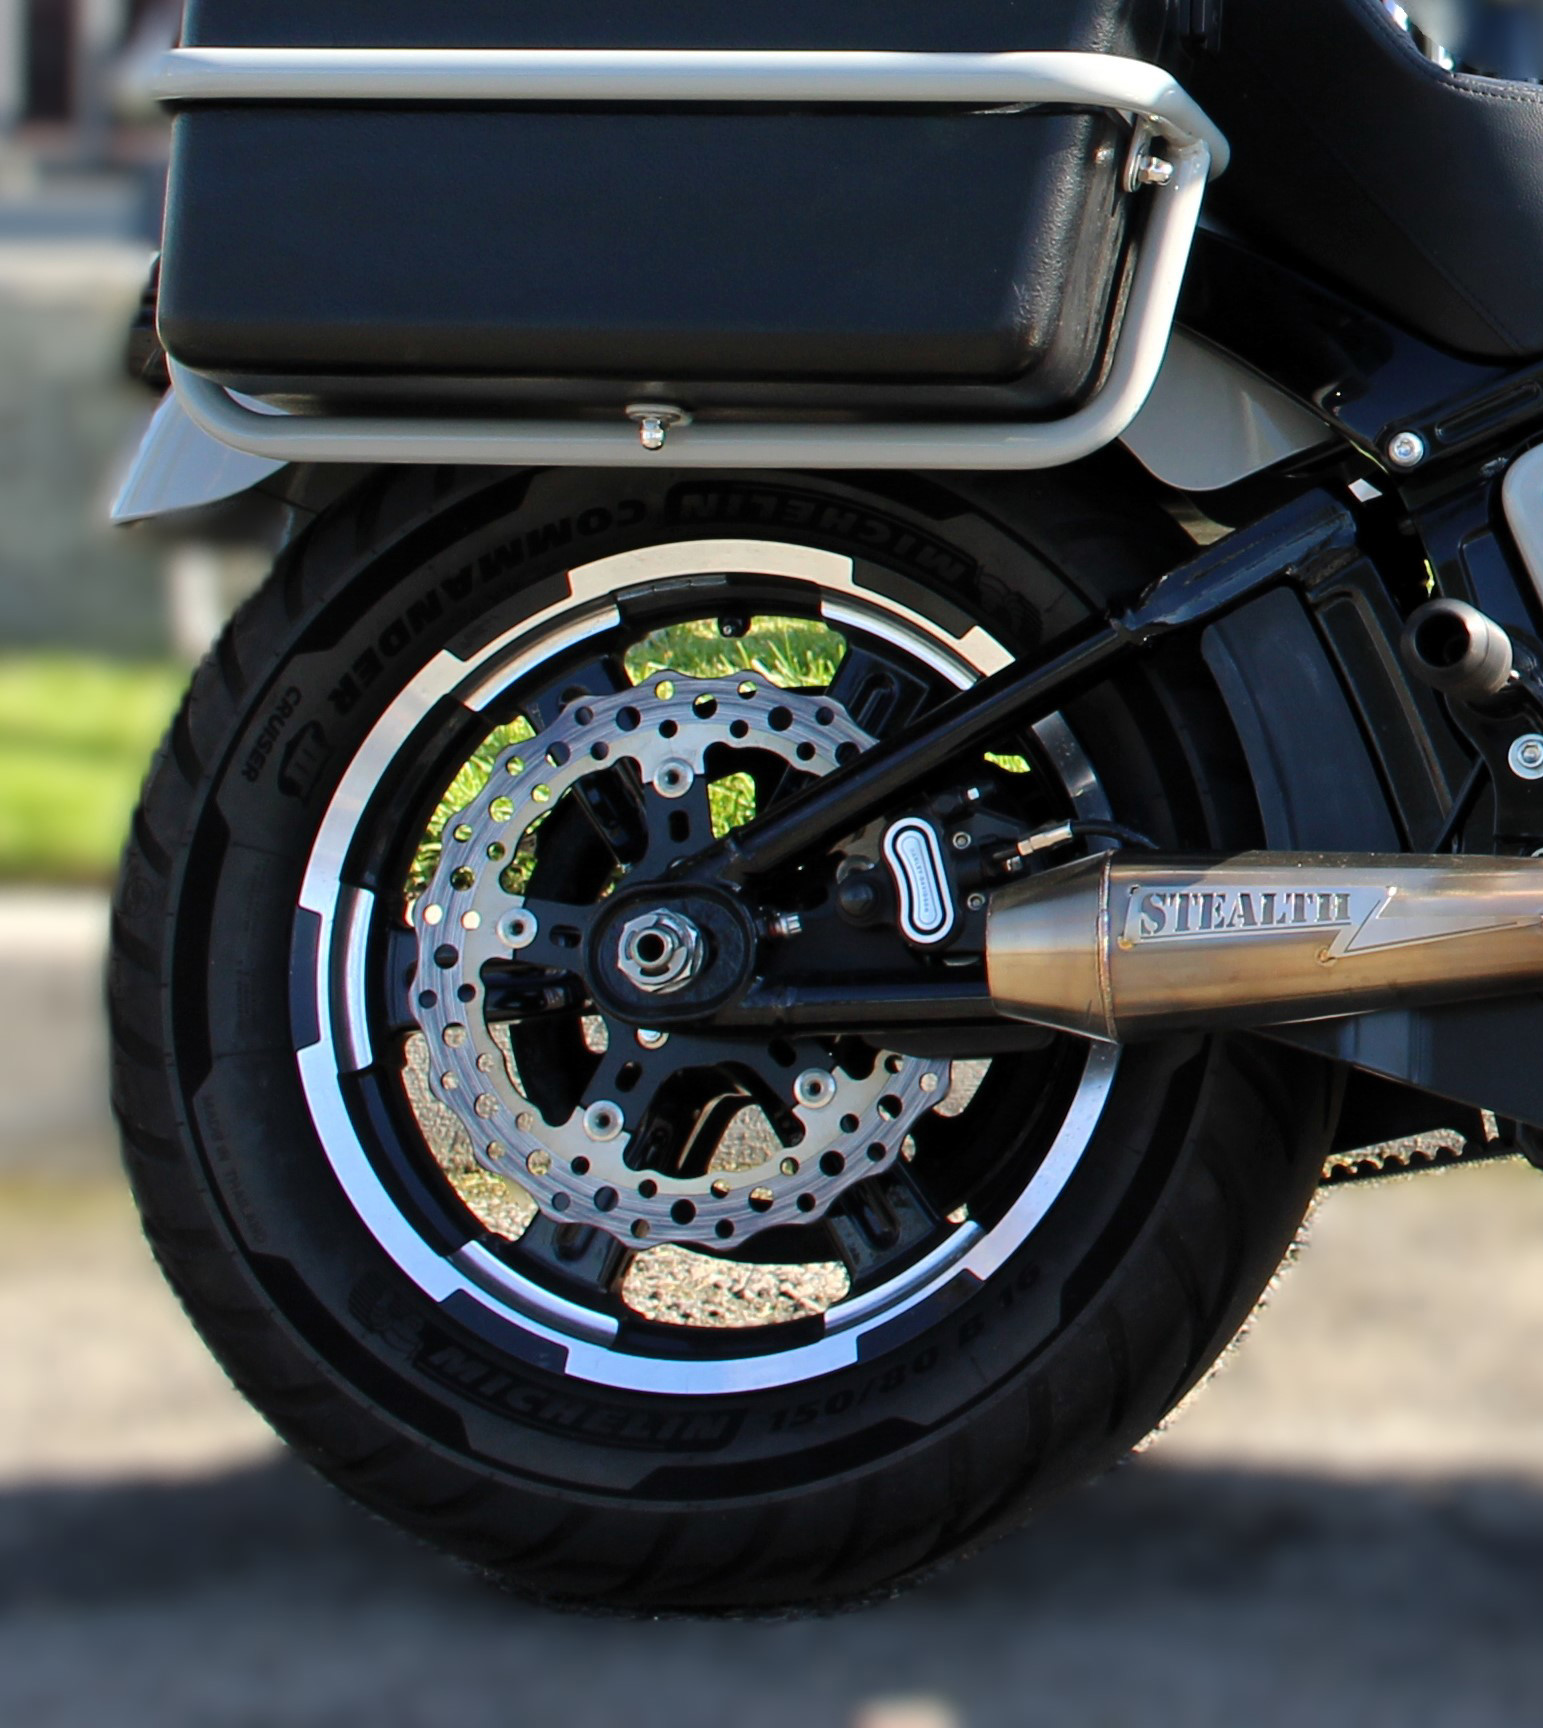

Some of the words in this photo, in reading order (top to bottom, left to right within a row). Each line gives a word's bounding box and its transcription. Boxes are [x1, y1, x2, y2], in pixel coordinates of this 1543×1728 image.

[680, 491, 967, 582] MICHELIN
[327, 498, 648, 718] COMMANDER
[241, 685, 302, 783] CRUISER
[1141, 891, 1351, 936] STEALTH
[428, 1344, 729, 1443] MICHELIN
[768, 1346, 941, 1433] 150/80
